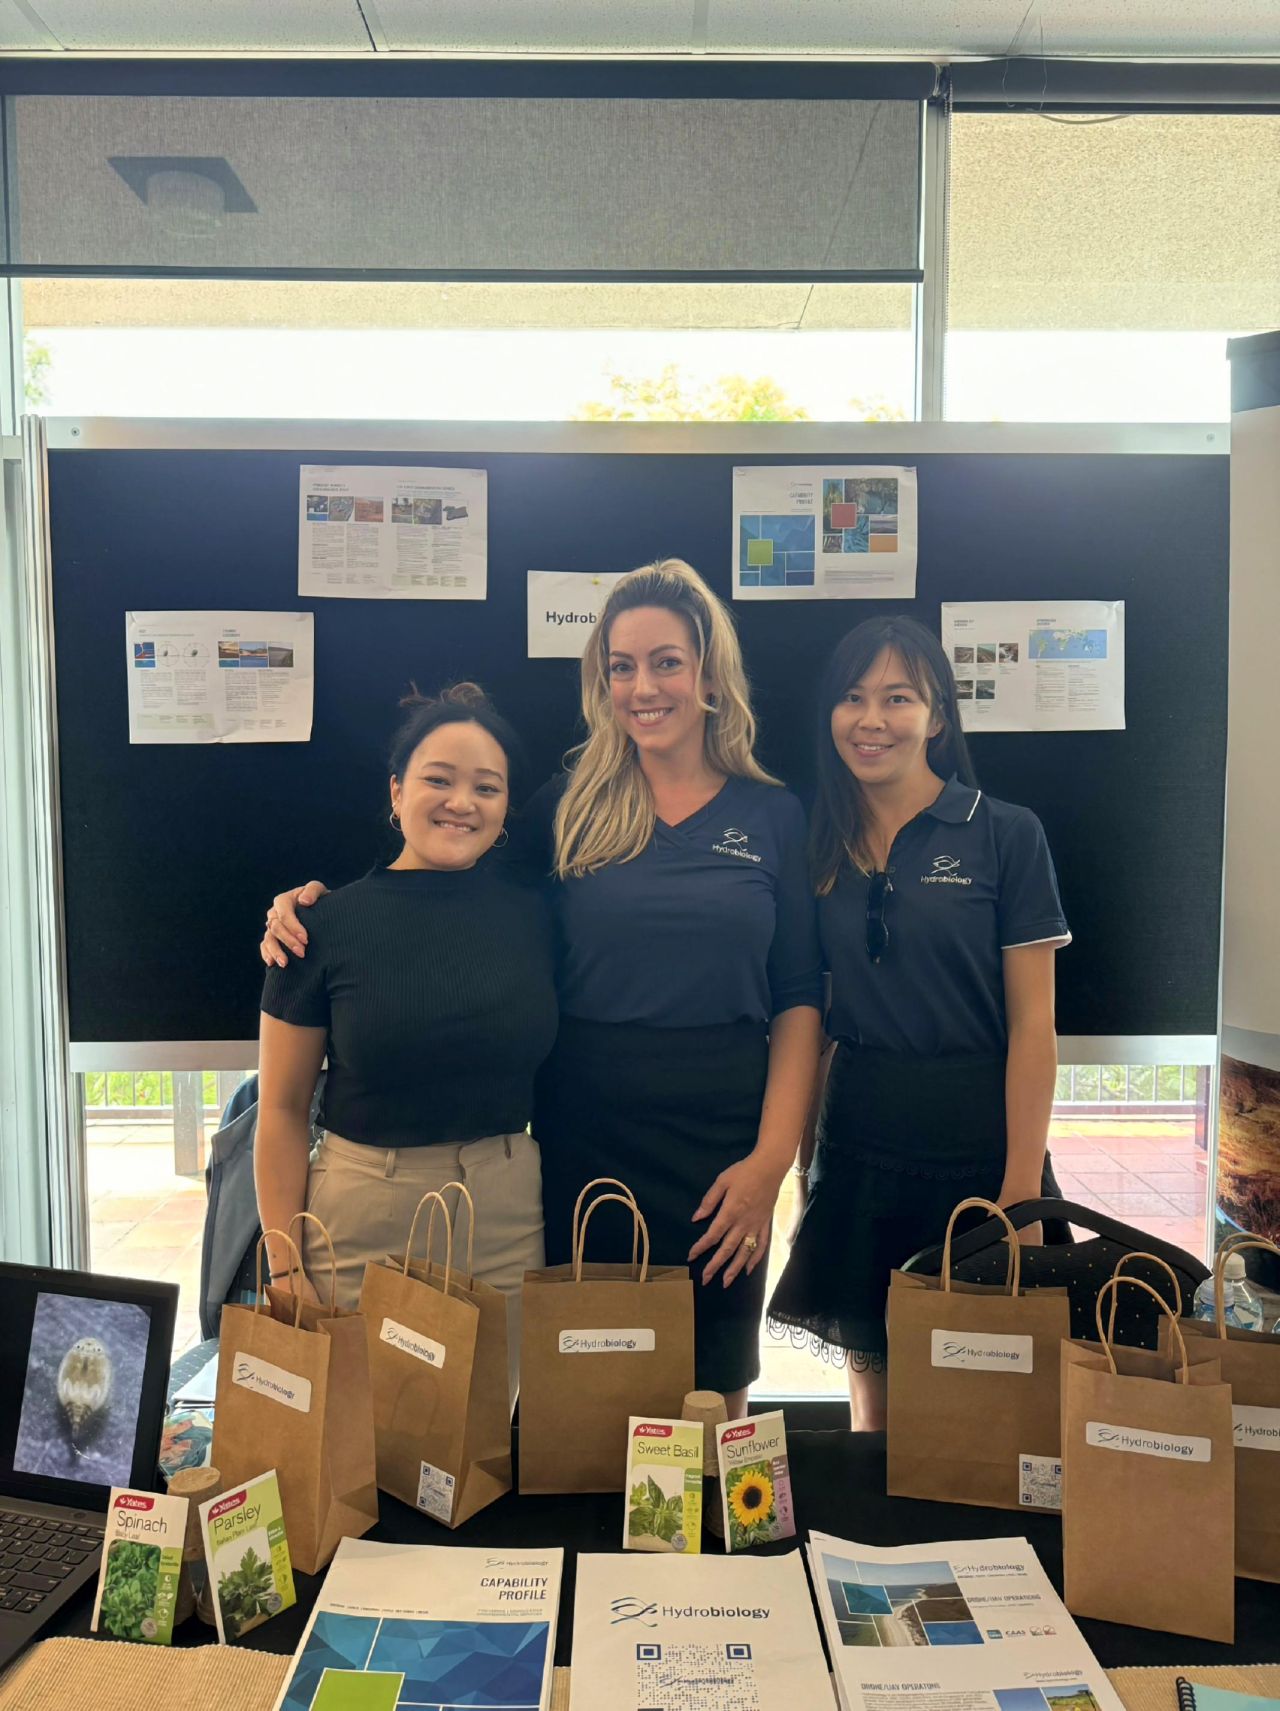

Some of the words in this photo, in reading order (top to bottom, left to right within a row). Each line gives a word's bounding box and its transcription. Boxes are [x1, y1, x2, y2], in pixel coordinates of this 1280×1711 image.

[546, 611, 597, 625] Hydrob
[712, 844, 761, 862] Hydrobiology
[920, 875, 972, 885] Hydrobiology
[580, 1338, 636, 1350] Hydrobiology
[967, 1347, 1020, 1360] Hydrobiology
[256, 1376, 294, 1399] Hydrobiology
[1245, 1426, 1280, 1438] Hydrobi
[638, 1441, 671, 1456] Sweet
[673, 1444, 699, 1458] Basil
[727, 1437, 780, 1459] Sunflower
[1121, 1434, 1194, 1456] Hydrobiology
[126, 1497, 147, 1509] Yates
[117, 1510, 167, 1534] Spinach
[214, 1504, 261, 1534] Parsley
[967, 1564, 1024, 1574] Hydrobiology
[480, 1577, 548, 1588] CAPABILITY
[499, 1589, 547, 1600] PROFILE
[662, 1606, 770, 1619] Hydrobiology
[861, 1683, 900, 1691] DRONE/UAV
